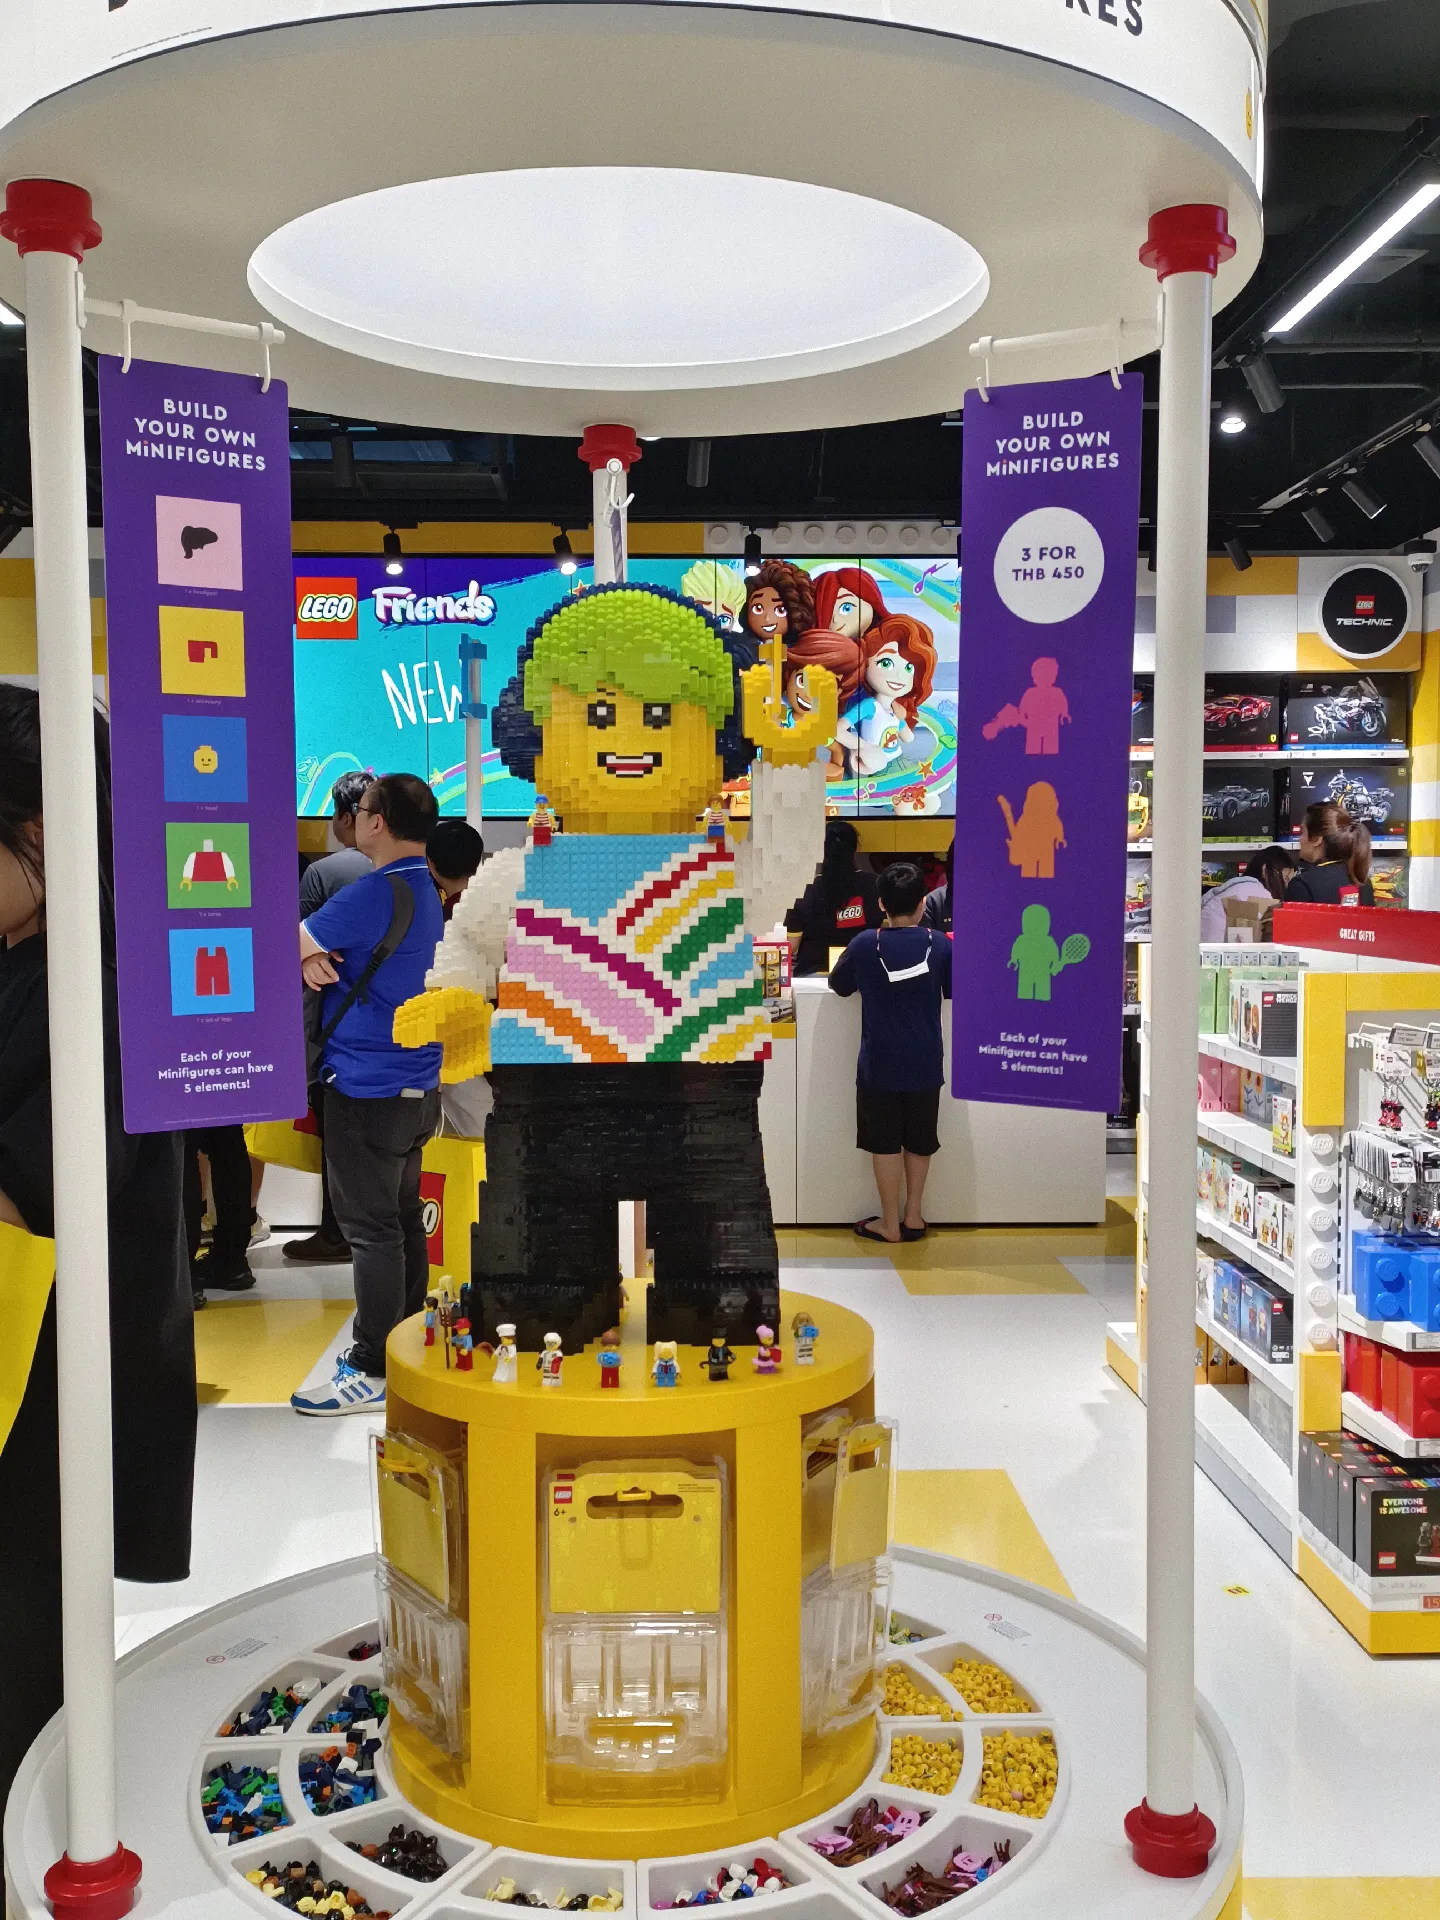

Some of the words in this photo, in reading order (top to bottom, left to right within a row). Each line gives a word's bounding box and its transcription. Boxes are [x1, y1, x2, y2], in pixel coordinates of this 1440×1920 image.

[163, 398, 228, 421] BUILD
[1023, 411, 1084, 430] BUILD
[134, 417, 195, 440] YOUR
[204, 427, 256, 448] OWN
[996, 436, 1051, 454] YOUR
[1060, 431, 1110, 449] OWN
[1021, 547, 1032, 562] 3
[1039, 545, 1077, 561] FOR
[1012, 568, 1046, 581] THB
[1052, 566, 1085, 579] 450
[299, 595, 355, 620] LEGO
[372, 580, 496, 625] Friends
[1336, 618, 1393, 626] TECHNIC
[838, 906, 862, 920] LEGO
[1339, 928, 1357, 940] GREAT
[1359, 930, 1375, 942] GIFTS
[1000, 1032, 1025, 1043] Each
[1028, 1033, 1040, 1044] of
[1042, 1037, 1067, 1047] your
[180, 1051, 208, 1062] Each
[211, 1049, 223, 1060] of
[226, 1050, 252, 1062] your
[978, 1044, 1037, 1058] Minifigures
[1040, 1051, 1059, 1060] can
[1062, 1050, 1088, 1063] have
[158, 1067, 222, 1080] Minifigures
[224, 1065, 245, 1075] can
[247, 1062, 274, 1073] have
[1011, 1061, 1063, 1075] elements!
[184, 1083, 192, 1093] 5
[194, 1079, 251, 1093] elements!
[1382, 1497, 1424, 1507] EVERYONE
[553, 1507, 567, 1516] 6+
[1379, 1507, 1387, 1515] IS
[1388, 1506, 1428, 1514] AWESOME
